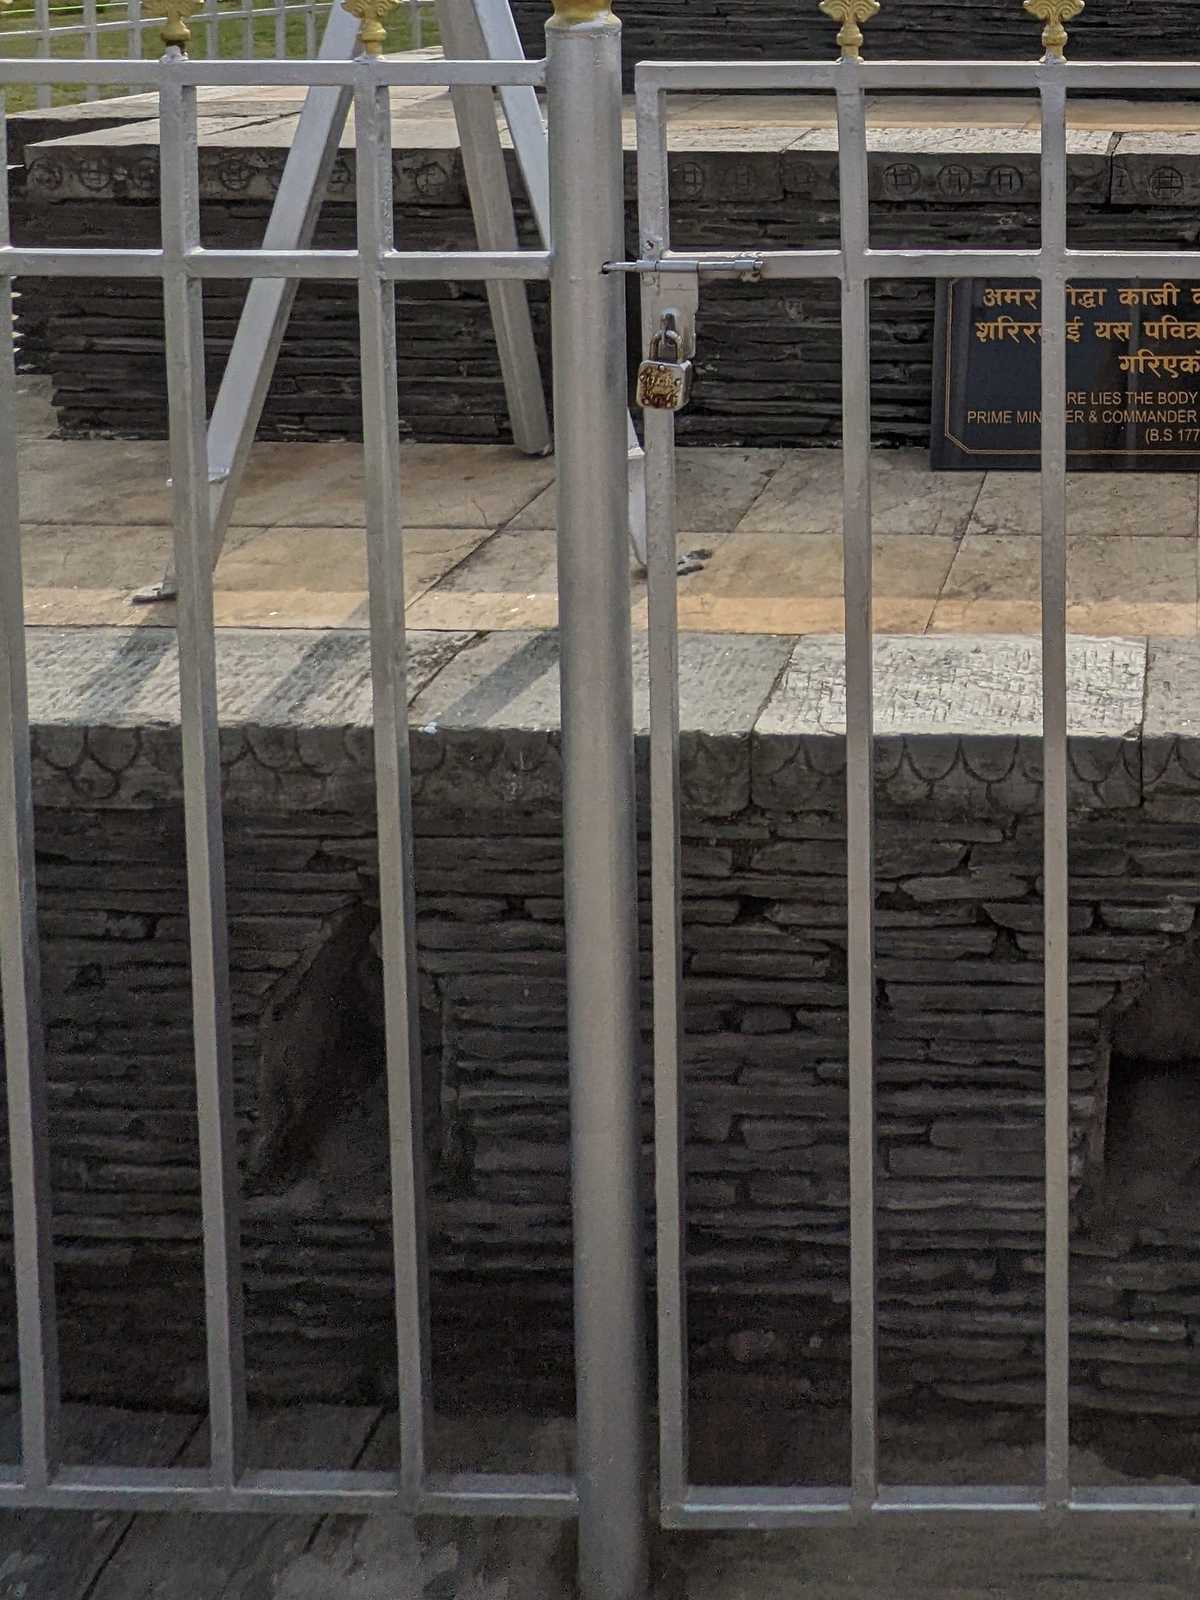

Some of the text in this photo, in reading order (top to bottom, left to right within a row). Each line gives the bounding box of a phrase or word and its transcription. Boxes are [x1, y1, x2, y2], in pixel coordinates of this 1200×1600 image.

[983, 287, 1041, 310] अमर
[1053, 284, 1108, 309] ोद्धा
[1118, 282, 1180, 307] काजी
[1094, 321, 1131, 342] यस
[1050, 391, 1086, 405] RE
[1090, 391, 1122, 405] LIES
[1127, 391, 1153, 405] THE
[1158, 391, 1198, 405] BODY
[967, 410, 1012, 425] PRIME
[1016, 410, 1085, 424] MINER
[1088, 410, 1098, 424] &
[1102, 410, 1198, 424] COMMANDER
